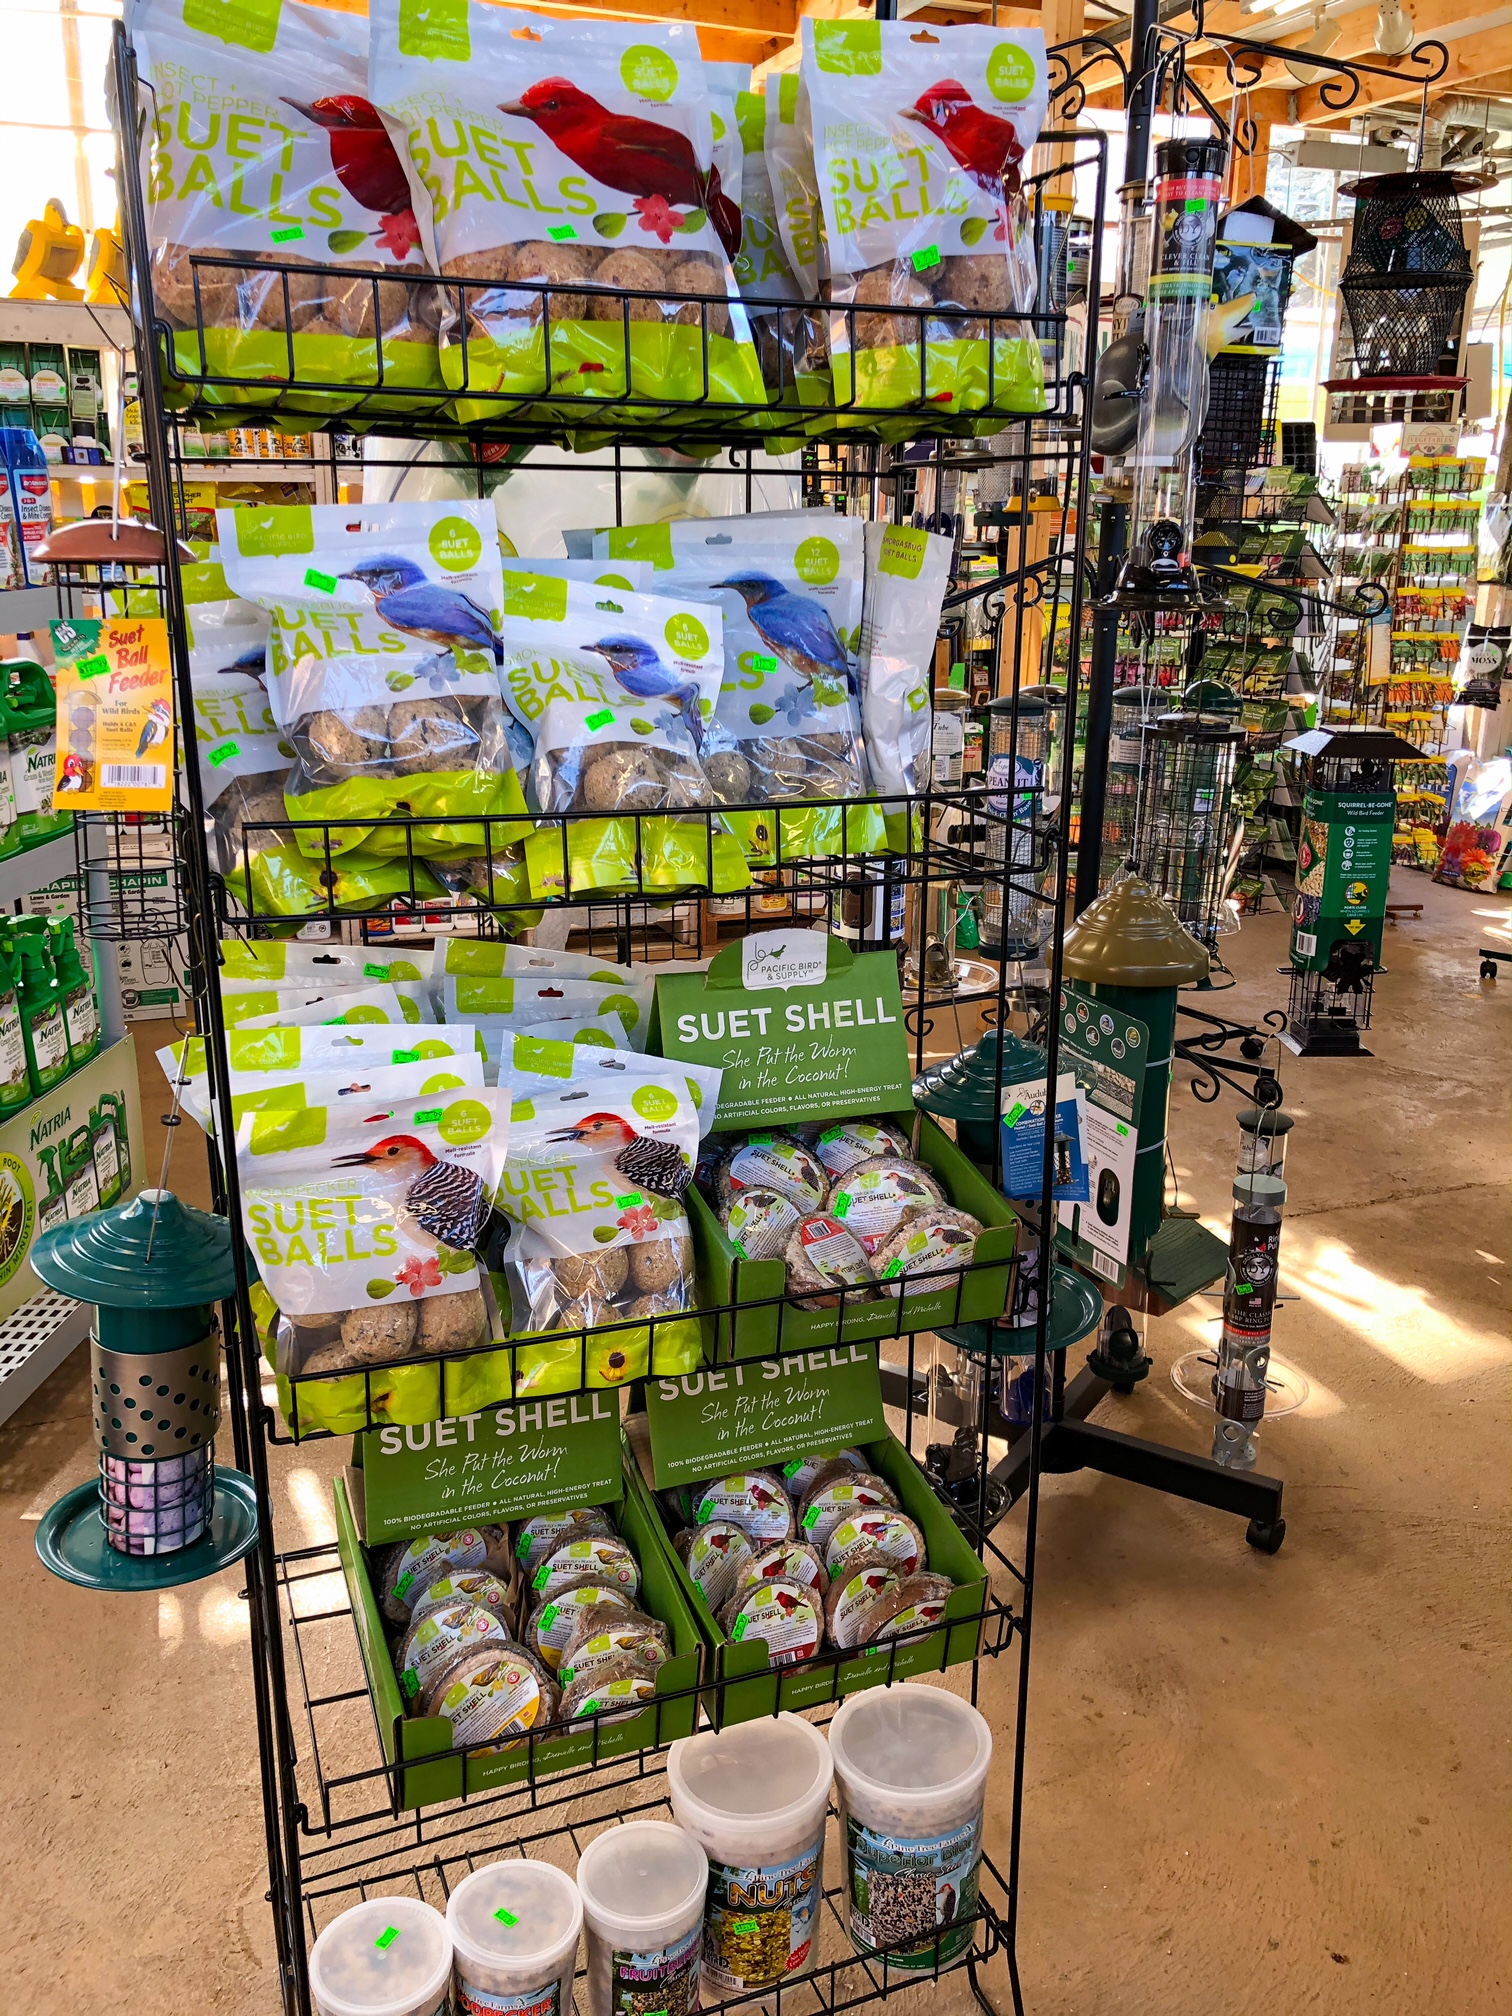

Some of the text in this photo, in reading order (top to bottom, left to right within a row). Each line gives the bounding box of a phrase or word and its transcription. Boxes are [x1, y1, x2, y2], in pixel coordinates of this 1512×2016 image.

[998, 66, 1024, 76] SUET
[995, 78, 1028, 88] BALLS
[151, 101, 308, 172] SUET
[408, 117, 535, 181] SUET
[826, 145, 934, 195] SUET
[148, 153, 343, 228] BALLS
[426, 160, 598, 224] BALLS
[833, 177, 970, 236] BALLS
[1408, 436, 1453, 444] VEGETABLES
[441, 538, 470, 549] SUET
[811, 548, 820, 556] 12
[882, 537, 922, 552] SMORGASBUG
[439, 549, 474, 560] BALLS
[805, 558, 828, 567] SUET
[895, 550, 917, 563] BALLS
[804, 567, 832, 576] BALLS
[109, 624, 144, 649] Suet
[674, 640, 703, 651] BALLS
[675, 631, 698, 642] SUET
[117, 645, 148, 669] Ball
[109, 668, 168, 694] Feeder
[508, 657, 605, 693] SUET
[102, 707, 119, 715] Wild
[108, 876, 162, 887] CHAPIN
[761, 963, 796, 973] PACIFIC
[73, 1000, 92, 1018] NATRIA
[677, 997, 896, 1043] SUET SHELL
[39, 1021, 62, 1043] NATRIA
[721, 1034, 858, 1070] She Put the Worm
[738, 1057, 850, 1090] in the Coconut!
[643, 1099, 666, 1107] SUET
[761, 1096, 786, 1104] FEEDER
[808, 1090, 838, 1099] NATURAL,
[840, 1086, 882, 1096] HIGH-ENERGY
[883, 1083, 903, 1091] TREAT
[641, 1104, 671, 1113] BALLS
[723, 1110, 759, 1119] ARTIFICIAL
[761, 1106, 788, 1116] COLORS,
[789, 1102, 820, 1112] FLAVORS,
[832, 1095, 880, 1107] PRESERVATIVES
[29, 1105, 72, 1153] NATRIA
[447, 1124, 481, 1135] BALLS
[451, 1118, 478, 1126] SUET
[96, 1141, 113, 1161] NATRIA
[3, 1158, 21, 1174] ROOT
[772, 1159, 792, 1175] SHELL
[72, 1177, 92, 1197] NATRIA
[869, 1193, 893, 1202] SHELL
[247, 1194, 362, 1235] SUET
[254, 1224, 398, 1267] BALLS
[919, 1249, 940, 1265] SHELL
[810, 1322, 835, 1330] HAPPY
[658, 1345, 868, 1401] SUET SHELL
[701, 1378, 831, 1424] She Put the Worm
[380, 1393, 612, 1455] SUET SHELL
[717, 1400, 823, 1441] in the Coconut!
[667, 1419, 874, 1469] 100% BIODEGRADABLE FEEDER ALL NATURAL, HIGH-ENERGY TREAT
[703, 1458, 738, 1471] ARTIFICIAL
[739, 1453, 766, 1464] COLORS,
[767, 1447, 796, 1458] FLAVORS,
[806, 1432, 853, 1448] PRESERVATIVES
[425, 1435, 568, 1481] She Put the Worm
[441, 1458, 560, 1499] in the Coconut!
[384, 1516, 402, 1525] 100%
[404, 1506, 462, 1523] BIODEGRADABLE
[464, 1502, 490, 1511] FEEDER
[513, 1492, 545, 1503] NATURAL,
[546, 1483, 591, 1496] HIGH-ENERGY
[592, 1479, 612, 1487] TREAT
[422, 1516, 461, 1529] ARTIFICIAL
[463, 1511, 492, 1522] COLORS,
[493, 1505, 525, 1516] FLAVORS,
[537, 1493, 588, 1507] PRESERVATIVES
[422, 1548, 444, 1564] SHELL
[705, 1552, 720, 1569] SHELL
[832, 1538, 873, 1564] SUET SHELL
[762, 1609, 781, 1619] SHELL
[840, 1592, 873, 1621] SUET SHELL
[411, 1635, 456, 1670] SUET SHELL
[574, 1660, 595, 1670] SUET
[791, 1685, 814, 1695] HAPPY
[462, 1691, 487, 1713] SHELL
[482, 1766, 508, 1777] HAPPY
[857, 1836, 937, 1866] Superior
[891, 1842, 914, 1852] Pine
[755, 1872, 777, 1882] Pine
[894, 1867, 933, 1879] Classic
[729, 1863, 817, 1909] NUTS
